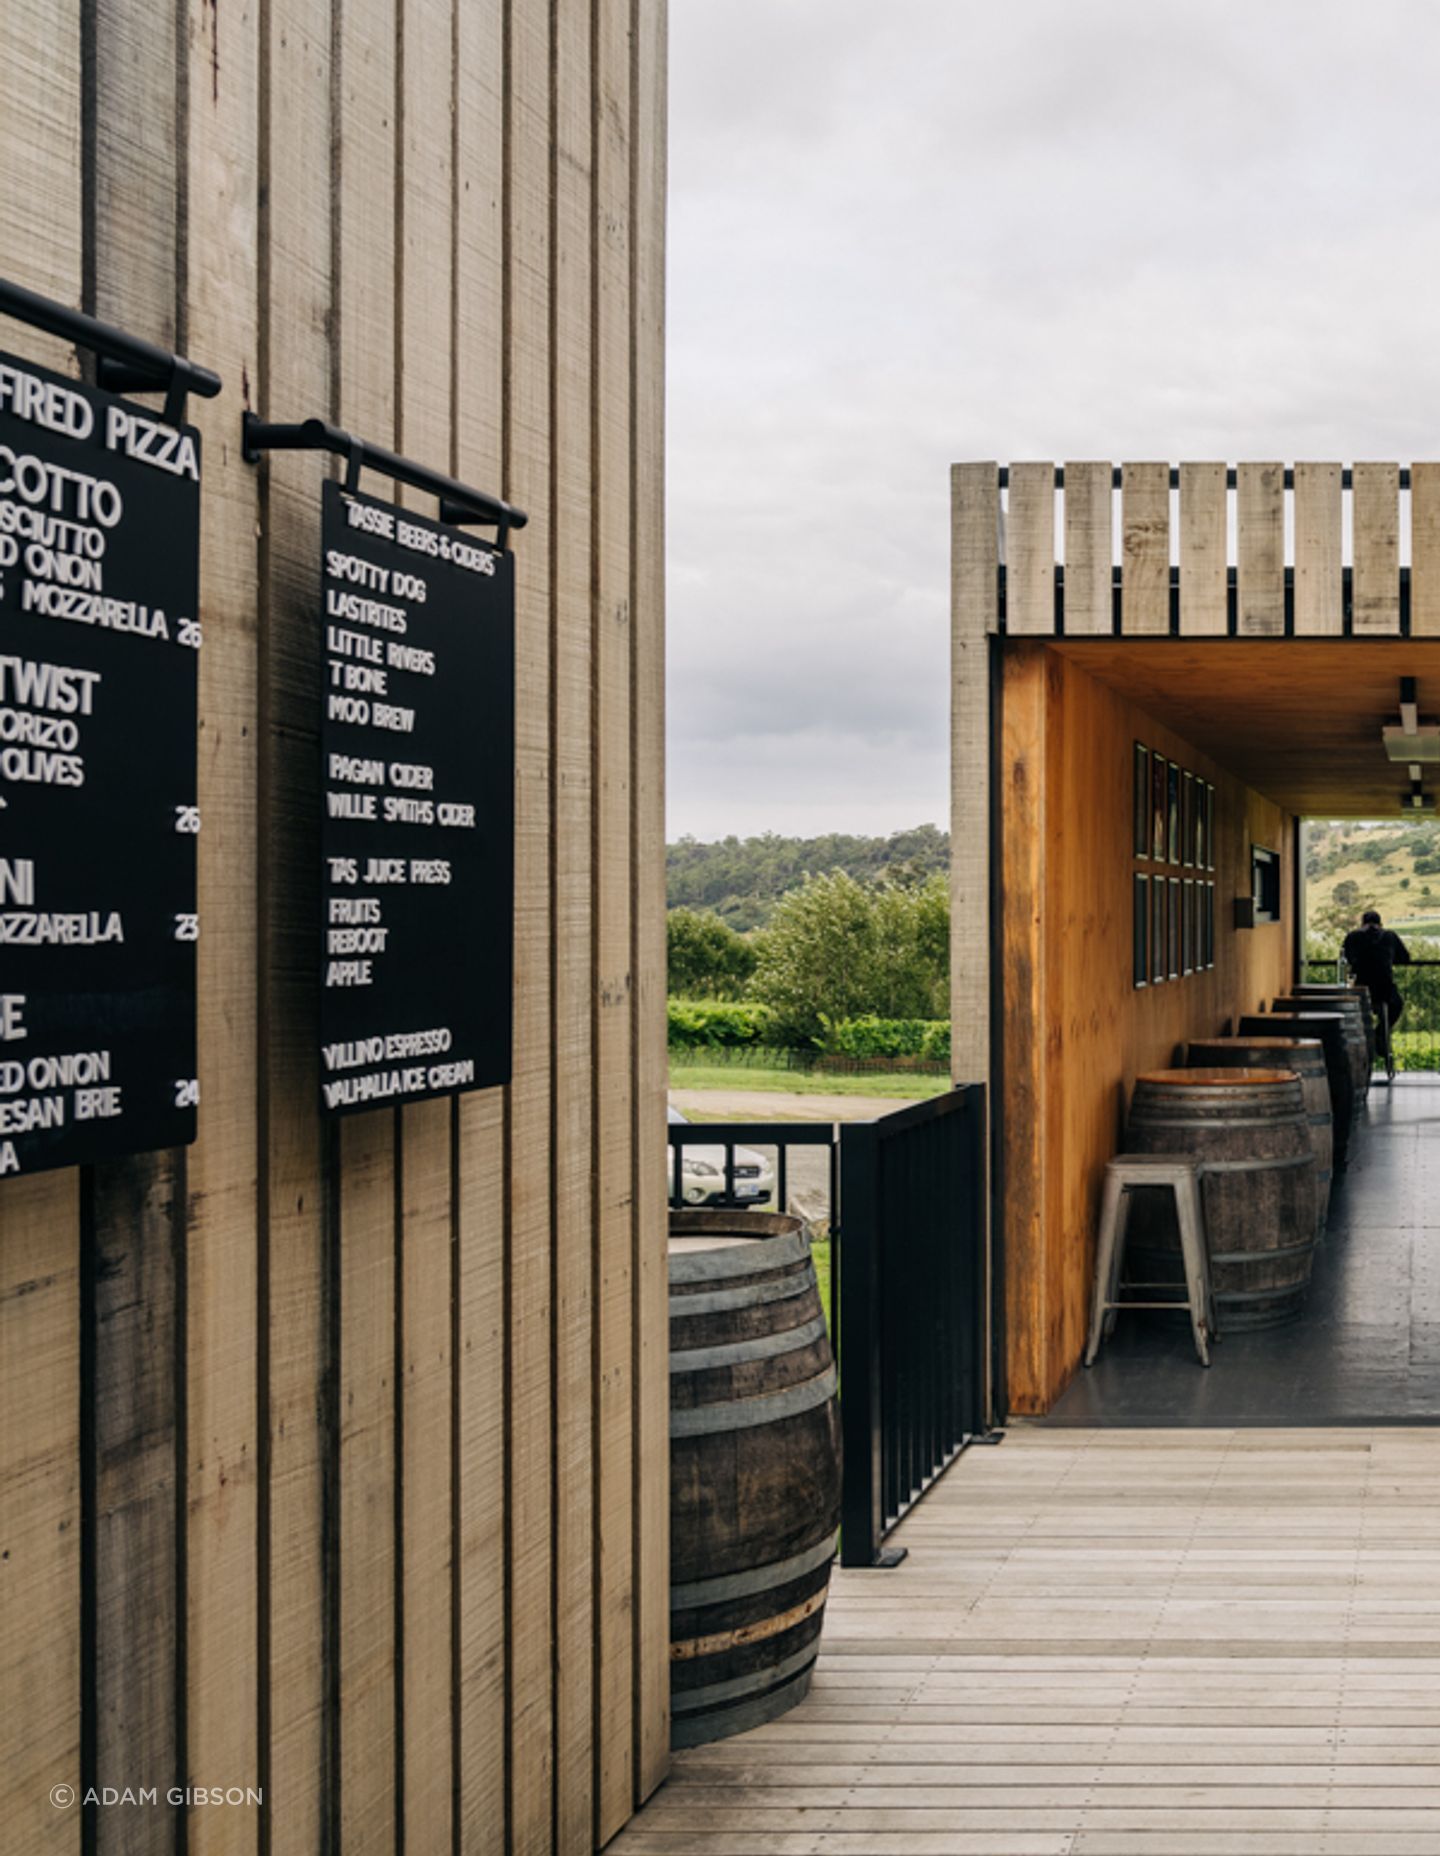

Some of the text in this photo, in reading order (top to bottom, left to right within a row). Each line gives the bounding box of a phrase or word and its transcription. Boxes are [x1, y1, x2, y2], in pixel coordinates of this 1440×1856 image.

[0, 363, 199, 481] FIRED PIZZA
[345, 500, 495, 577] TASSIE BEERS & CIDERS
[25, 544, 102, 590] ONION
[326, 550, 427, 603] SPOTTY DOG
[22, 579, 169, 640] MOZZARELLA
[177, 617, 203, 648] 26
[327, 625, 436, 676] LITTLE RIVERS
[0, 655, 101, 715] TWIST
[328, 660, 388, 695] T BONE
[328, 695, 415, 733] MOO BREW
[2, 748, 85, 787] OLIVES
[329, 753, 434, 791] PAGAN CIDER
[175, 805, 201, 833] 26
[326, 791, 378, 821] WILLIE
[436, 802, 476, 828] CIDER
[326, 858, 452, 885] TAS JUICE PRESS
[0, 911, 200, 945] ZZARELLA 23
[328, 898, 381, 924] FRUITS
[327, 927, 389, 955] REBOOT
[325, 960, 373, 987] APPLE
[322, 1028, 452, 1071] VILLINO ESPRESSO
[28, 1050, 110, 1090] ONION
[322, 1060, 475, 1110] VALHALLA ICE CREAM
[74, 1086, 123, 1120] BRIE
[175, 1078, 200, 1107] 24
